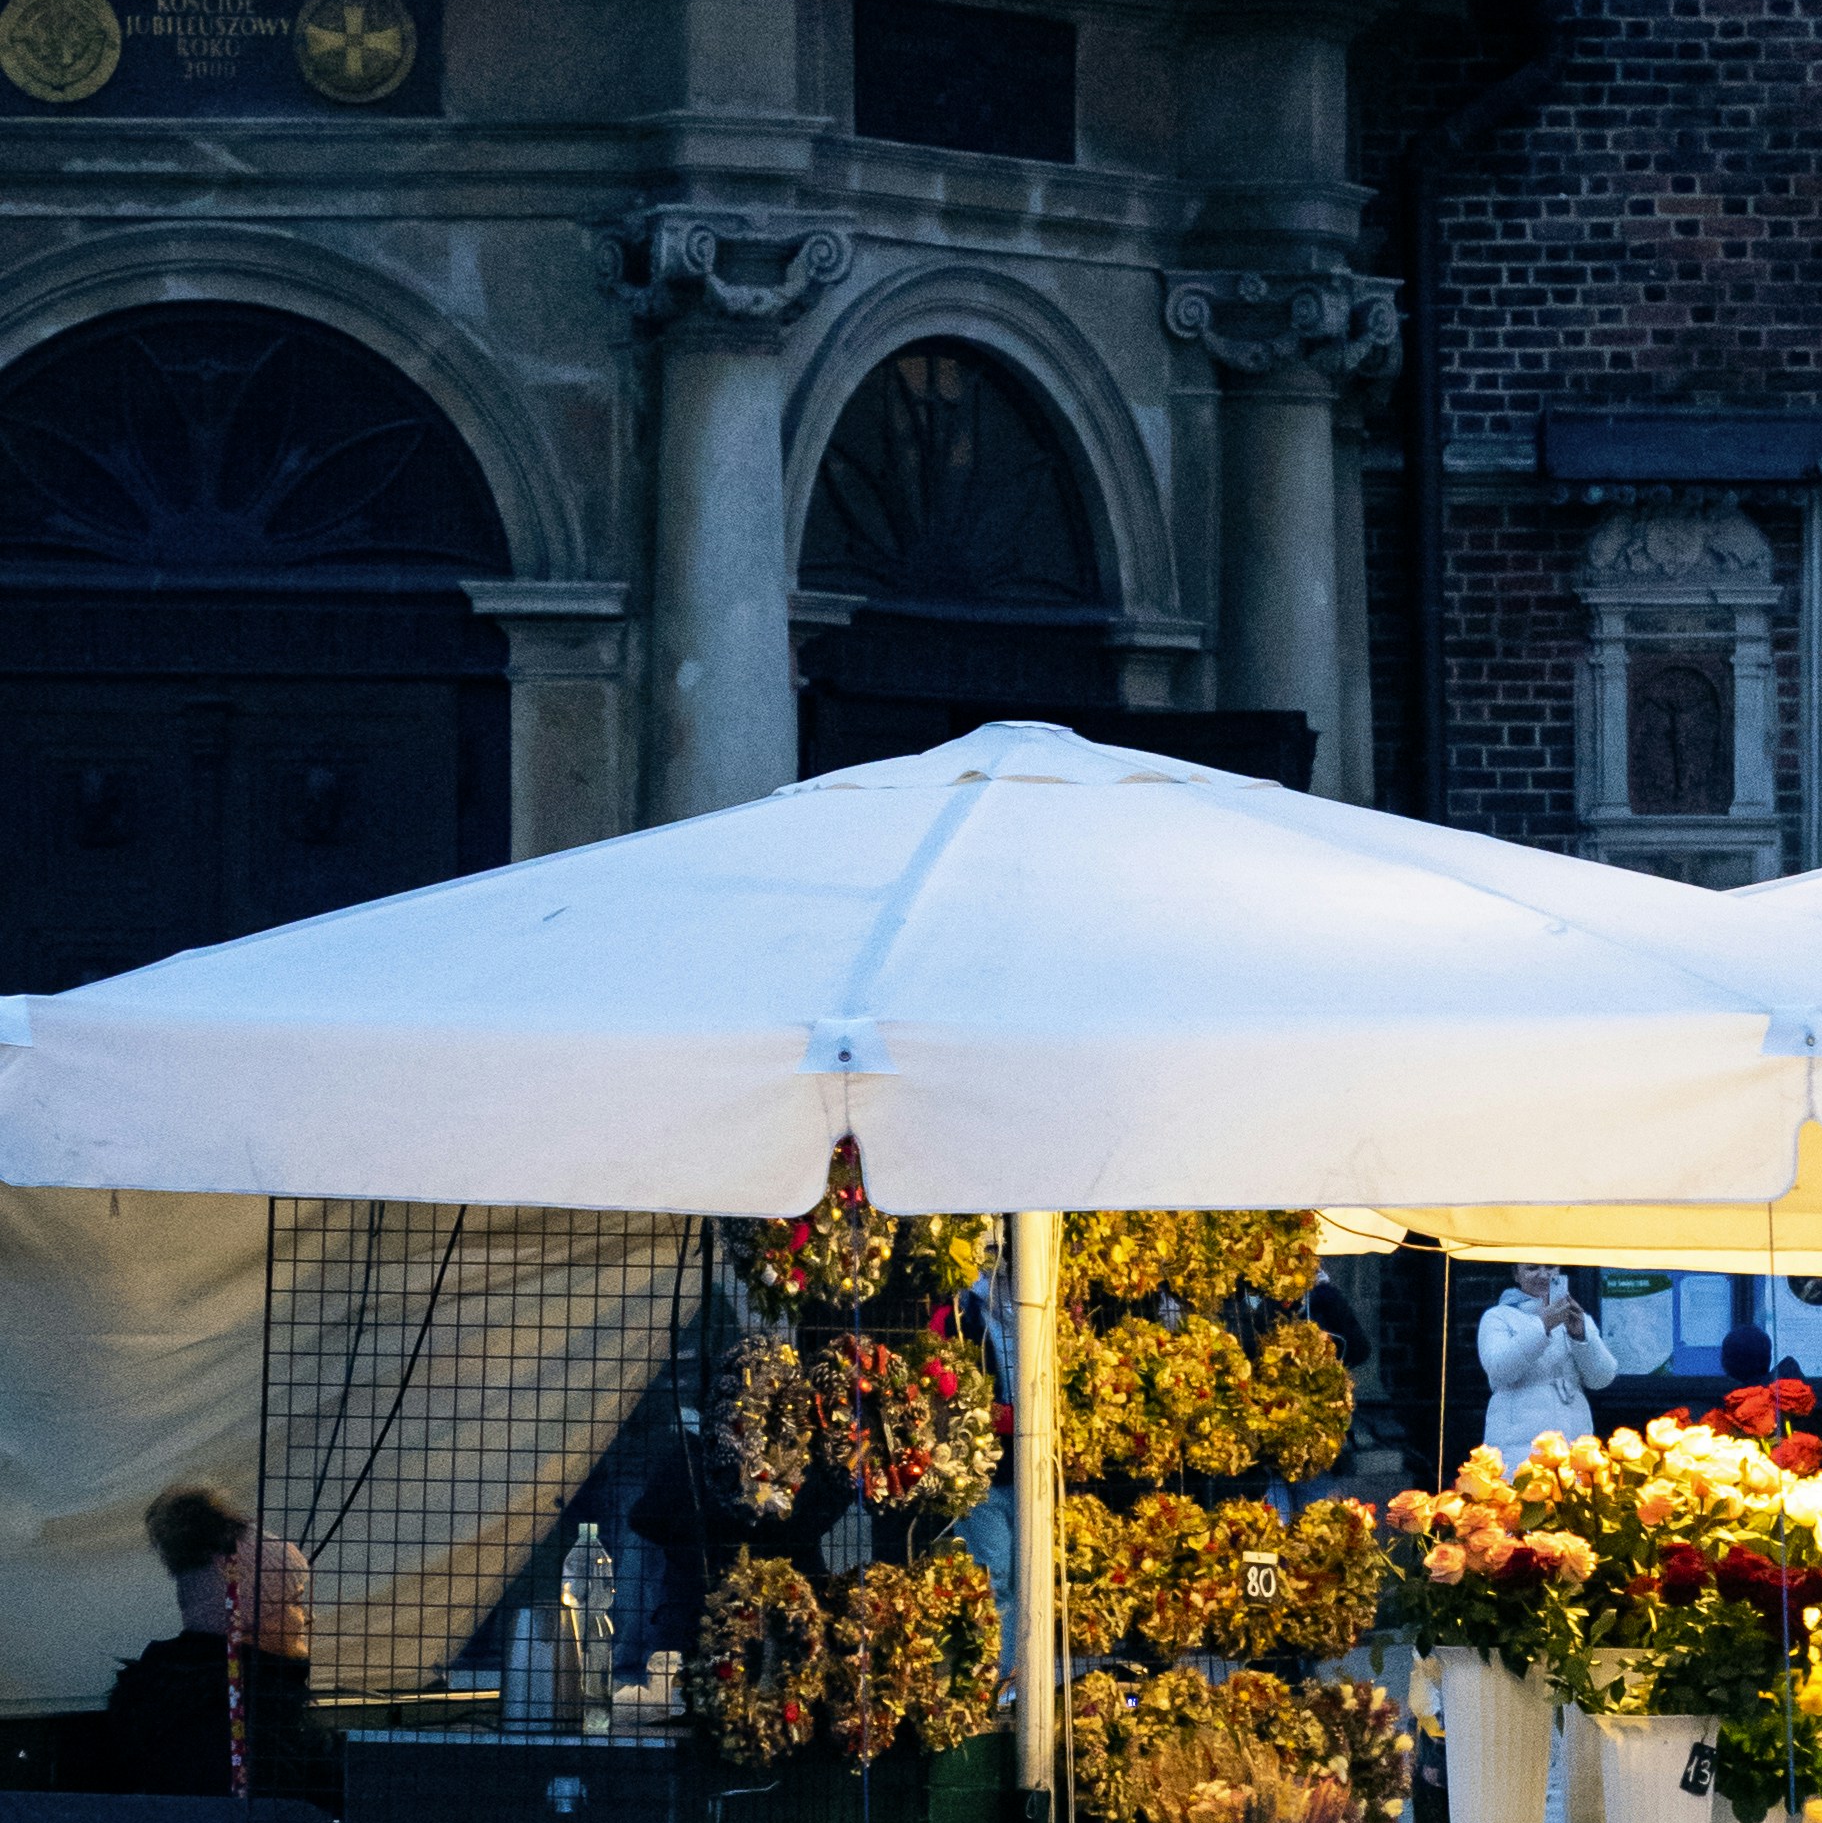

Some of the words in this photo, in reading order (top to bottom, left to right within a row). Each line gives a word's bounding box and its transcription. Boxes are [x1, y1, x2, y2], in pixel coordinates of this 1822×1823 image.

[126, 16, 291, 37] JUBILEUSZOWY
[177, 37, 239, 58] ROKU
[1247, 1566, 1276, 1598] 80
[1686, 1755, 1711, 1785] 13
